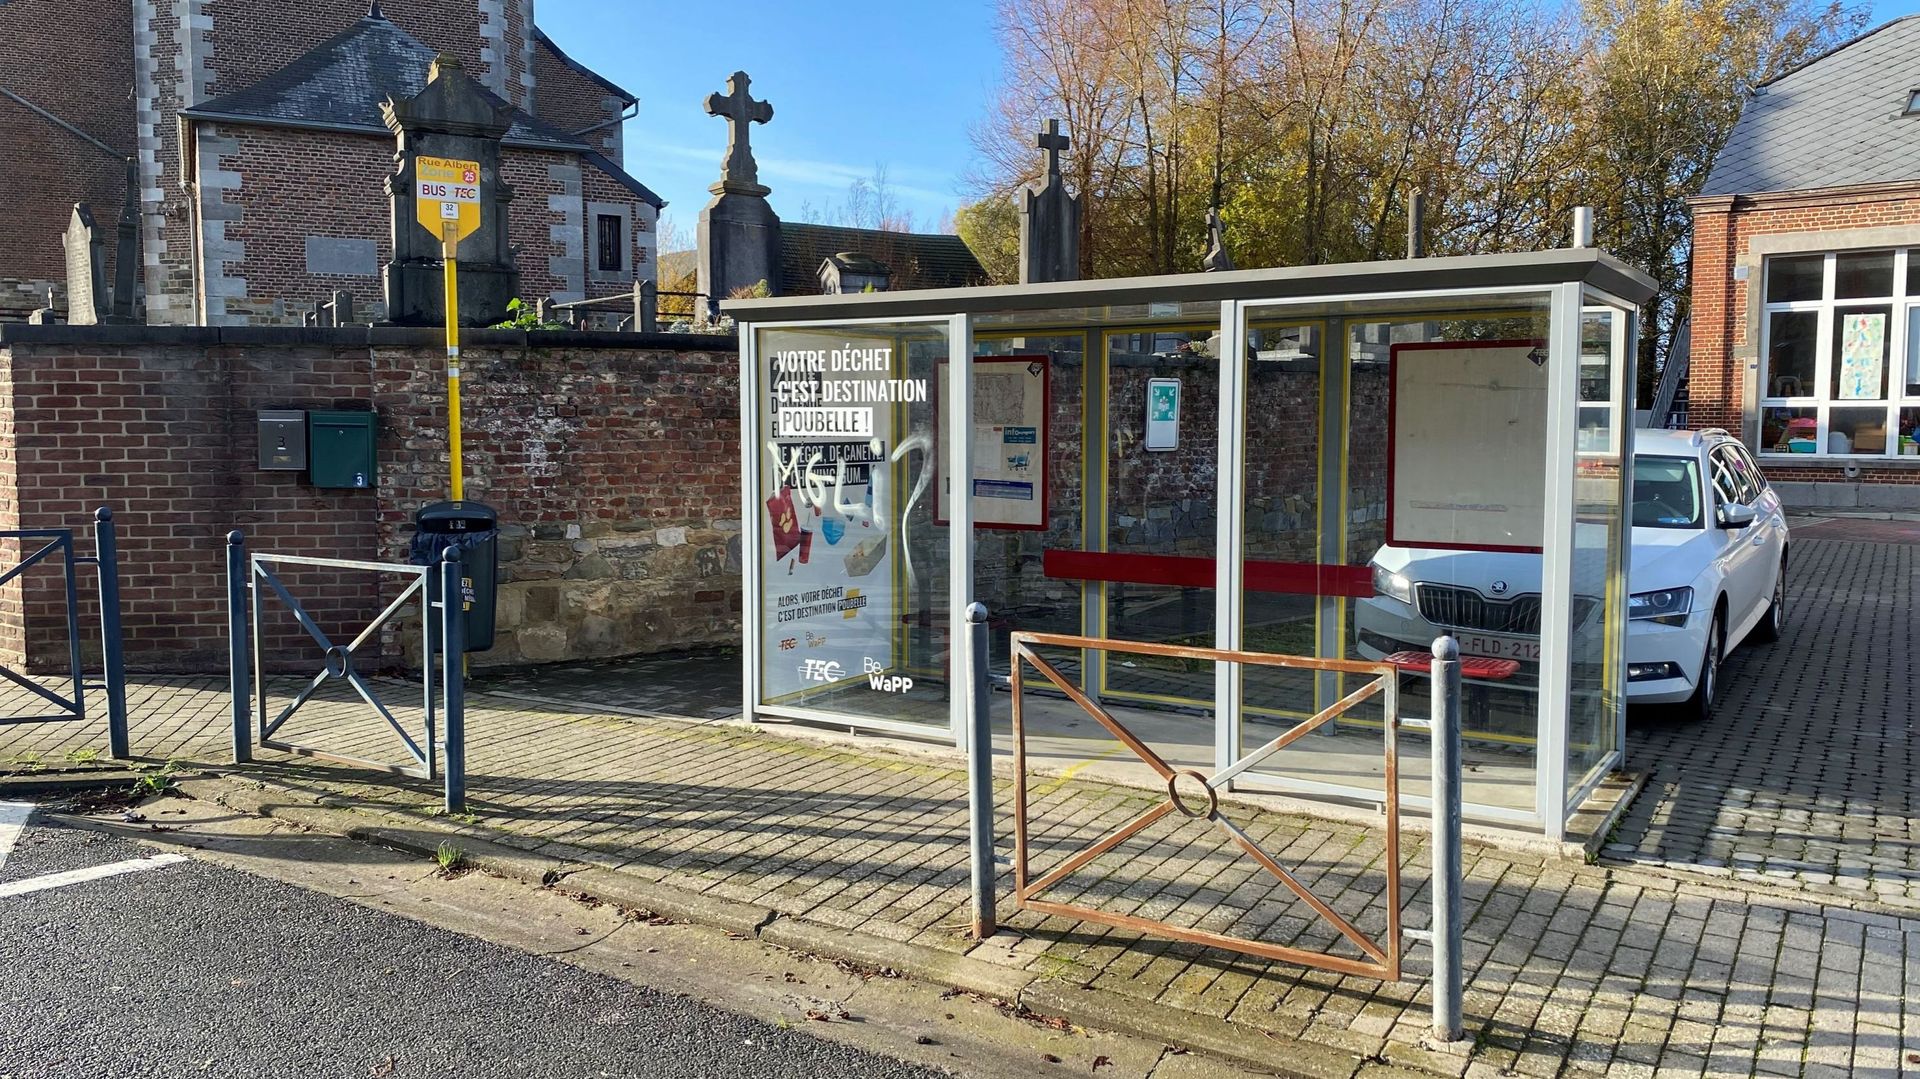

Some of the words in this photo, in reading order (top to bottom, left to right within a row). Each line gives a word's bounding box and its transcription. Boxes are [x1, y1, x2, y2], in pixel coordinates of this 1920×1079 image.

[419, 157, 441, 167] Rue
[443, 159, 478, 170] Albert
[464, 172, 474, 182] 25
[422, 184, 446, 197] BUS
[454, 187, 476, 199] TEC
[777, 350, 826, 372] VOTRE
[831, 343, 892, 372] DÉCHET
[778, 380, 818, 402] C'EST
[822, 379, 927, 402] DESTINATION
[782, 411, 860, 432] POUBELLE
[278, 436, 286, 447] 3
[356, 476, 363, 486] 3
[801, 588, 820, 603] VOTRE
[821, 586, 843, 600] DÉCHET
[778, 609, 795, 623] C'EST
[796, 602, 836, 619] DESTINATION
[838, 596, 866, 611] POUBELLE
[779, 638, 797, 651] TEC
[802, 659, 842, 683] TEC
